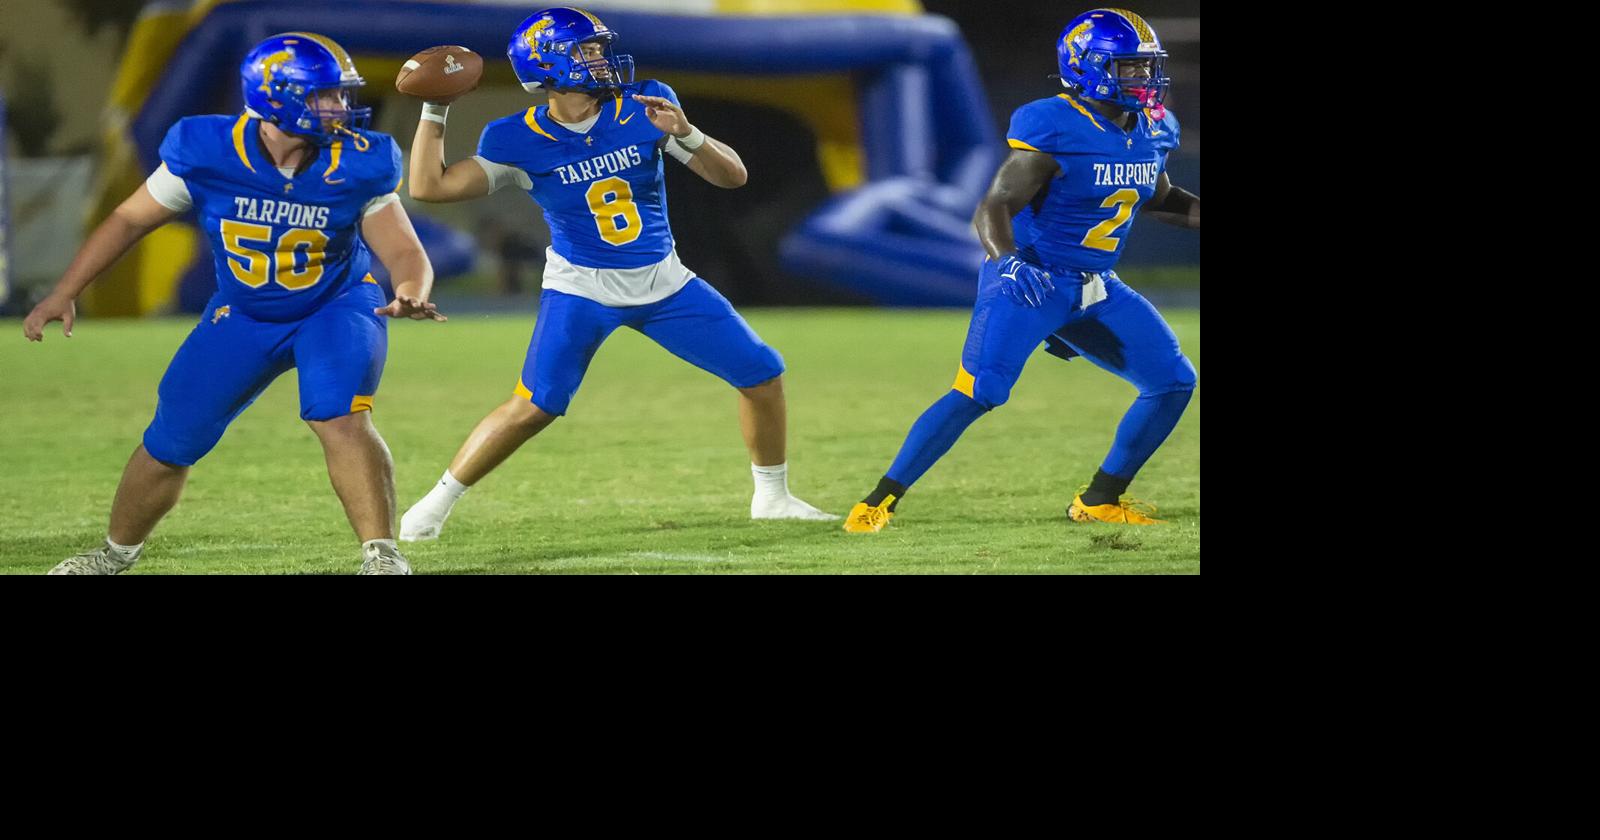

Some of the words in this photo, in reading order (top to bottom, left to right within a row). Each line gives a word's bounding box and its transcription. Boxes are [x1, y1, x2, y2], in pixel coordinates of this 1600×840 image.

[553, 145, 641, 184] TARPONS
[1093, 162, 1158, 186] TARPONS
[234, 196, 330, 228] TARPONS
[585, 175, 643, 247] 8
[1080, 188, 1140, 252] 2
[220, 218, 330, 291] 50
